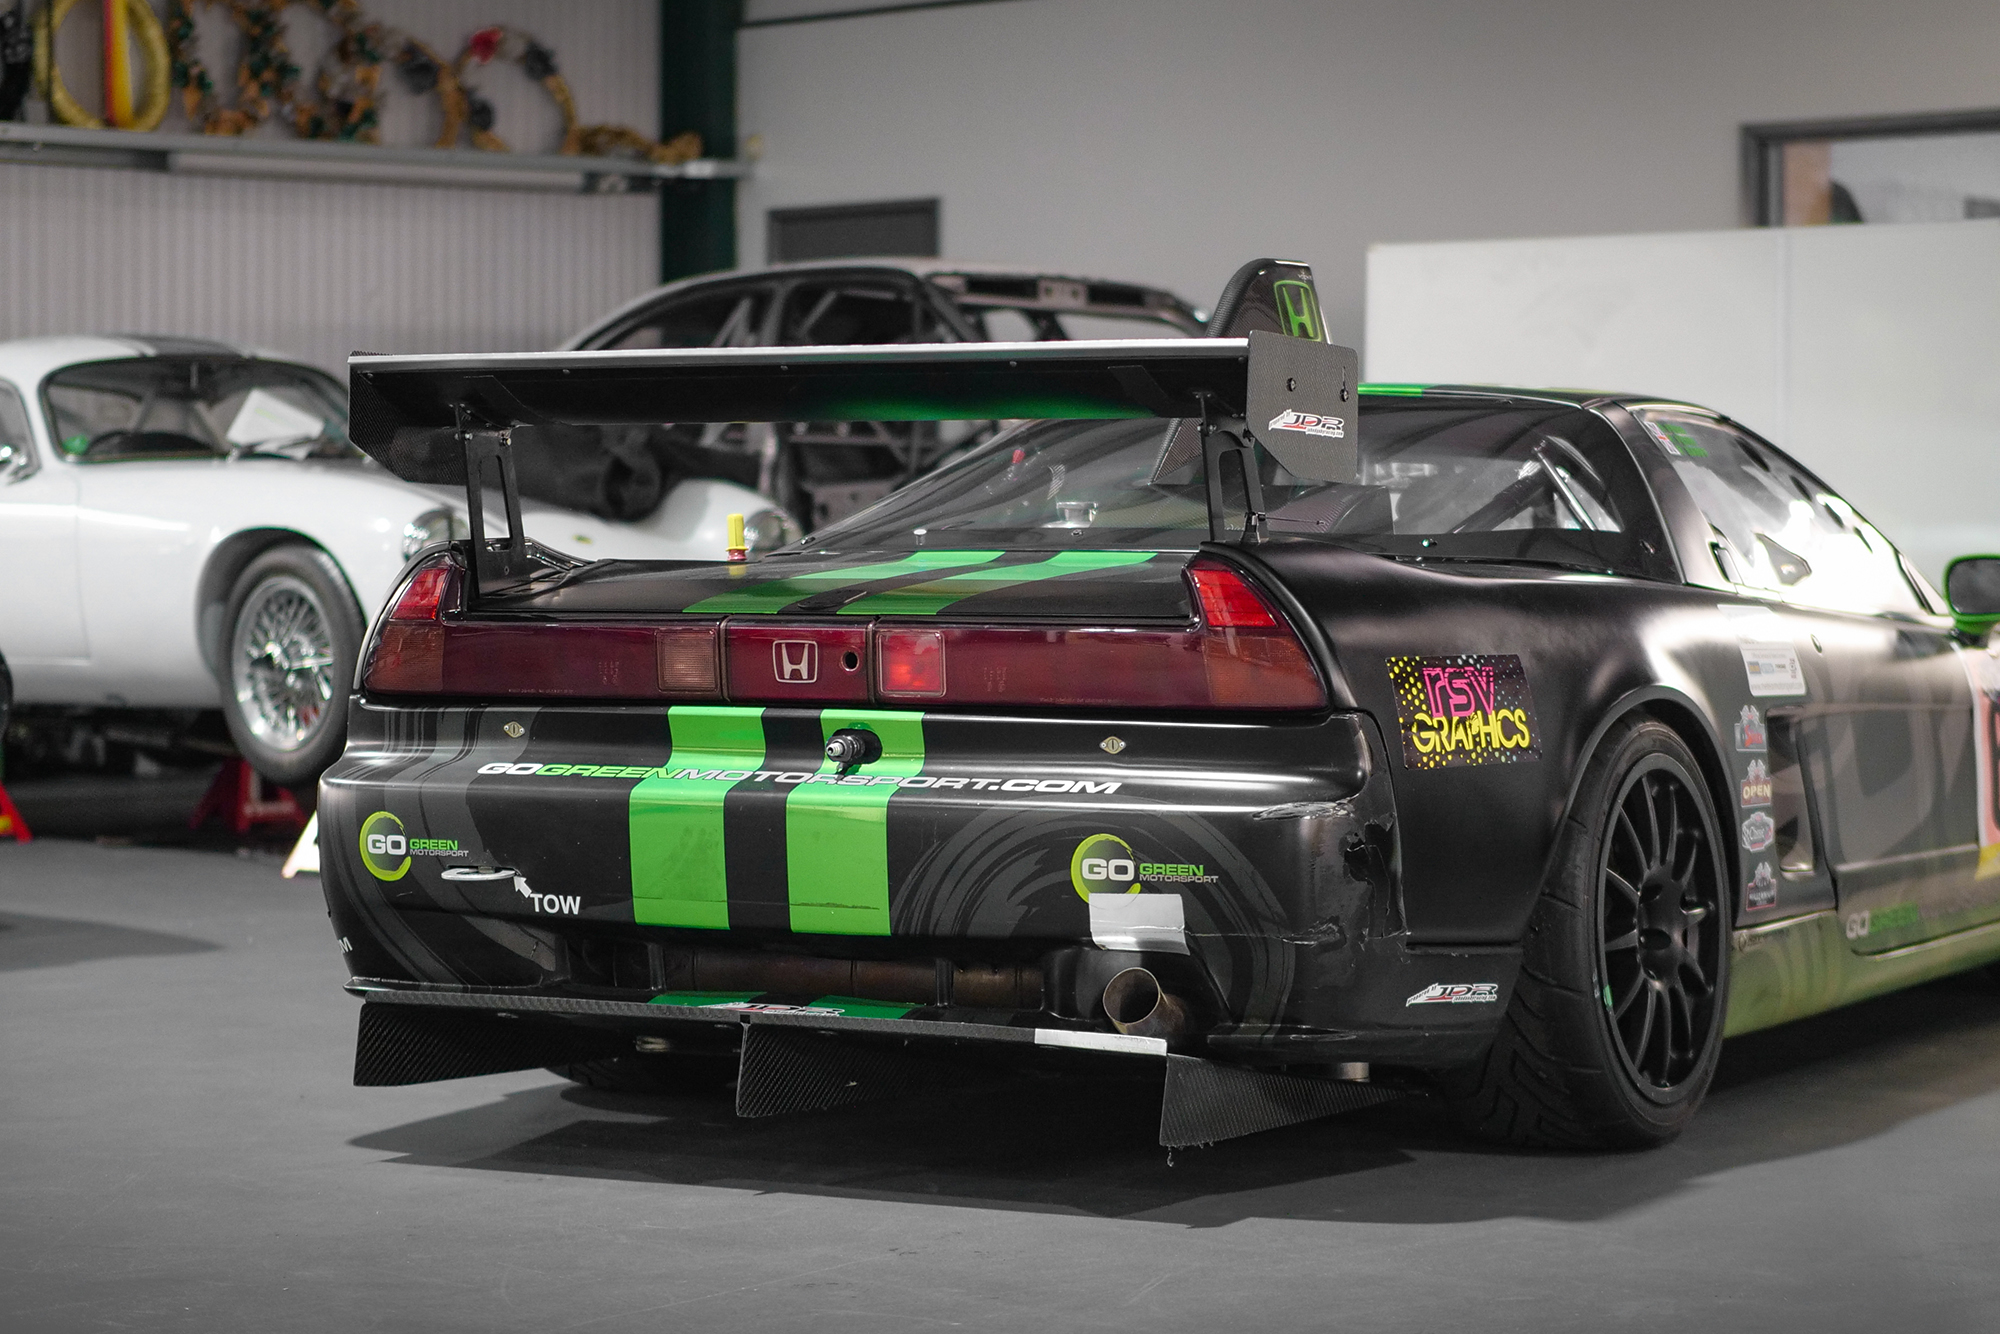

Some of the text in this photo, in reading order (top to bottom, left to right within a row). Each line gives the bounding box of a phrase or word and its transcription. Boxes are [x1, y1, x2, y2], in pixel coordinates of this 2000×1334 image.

[1283, 413, 1344, 430] JDR
[1412, 709, 1530, 753] GRAPHICS
[1743, 784, 1771, 800] OPEN
[367, 834, 459, 856] GO GREEN
[409, 849, 469, 858] MOTORSPORT
[1081, 858, 1205, 882] GO GREEN
[1139, 874, 1219, 884] MOTORSPORT
[529, 893, 581, 915] TOW
[1425, 985, 1498, 997] JDR
